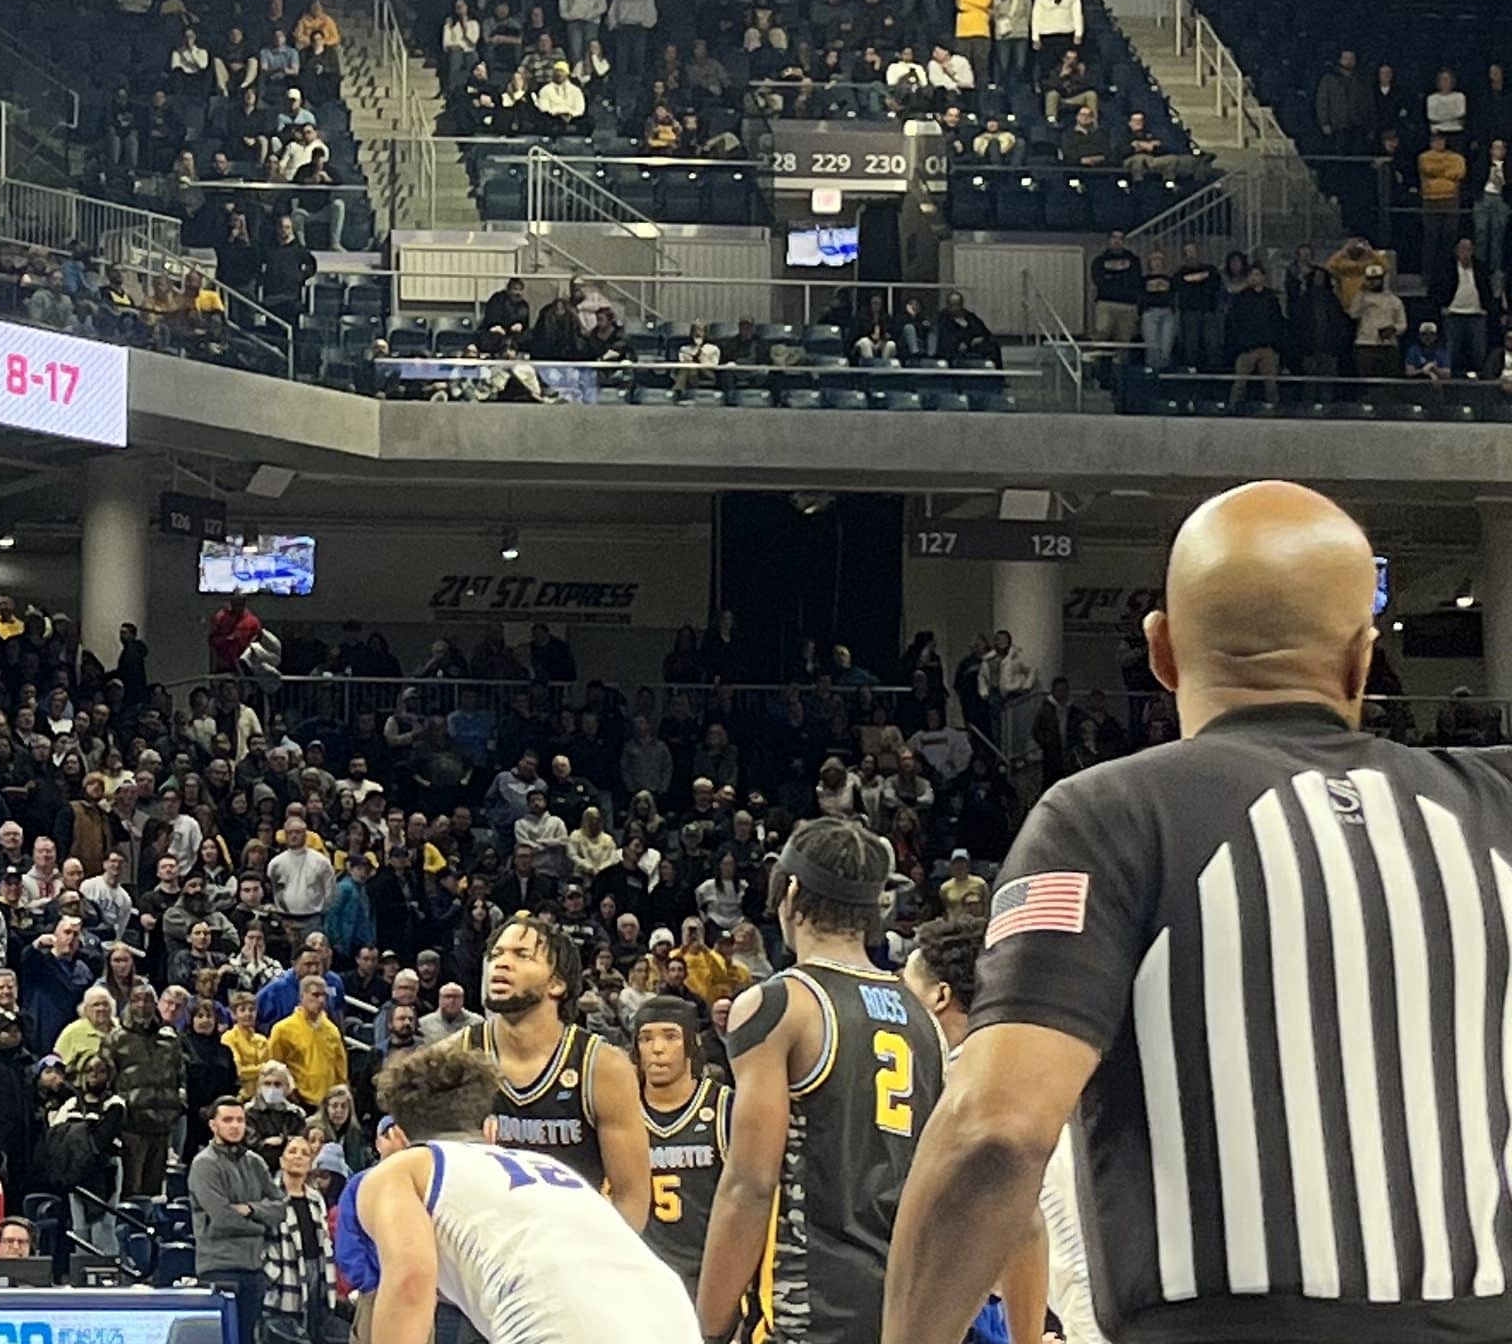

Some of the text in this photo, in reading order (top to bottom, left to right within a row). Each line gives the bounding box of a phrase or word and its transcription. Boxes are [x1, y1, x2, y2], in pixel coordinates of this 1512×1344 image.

[810, 153, 852, 173] 229
[863, 154, 907, 174] 230
[6, 352, 81, 406] 8-17
[917, 531, 1073, 557] 127 128
[858, 983, 909, 1026] ROSS
[873, 1029, 915, 1138] 2
[652, 1174, 682, 1224] 5
